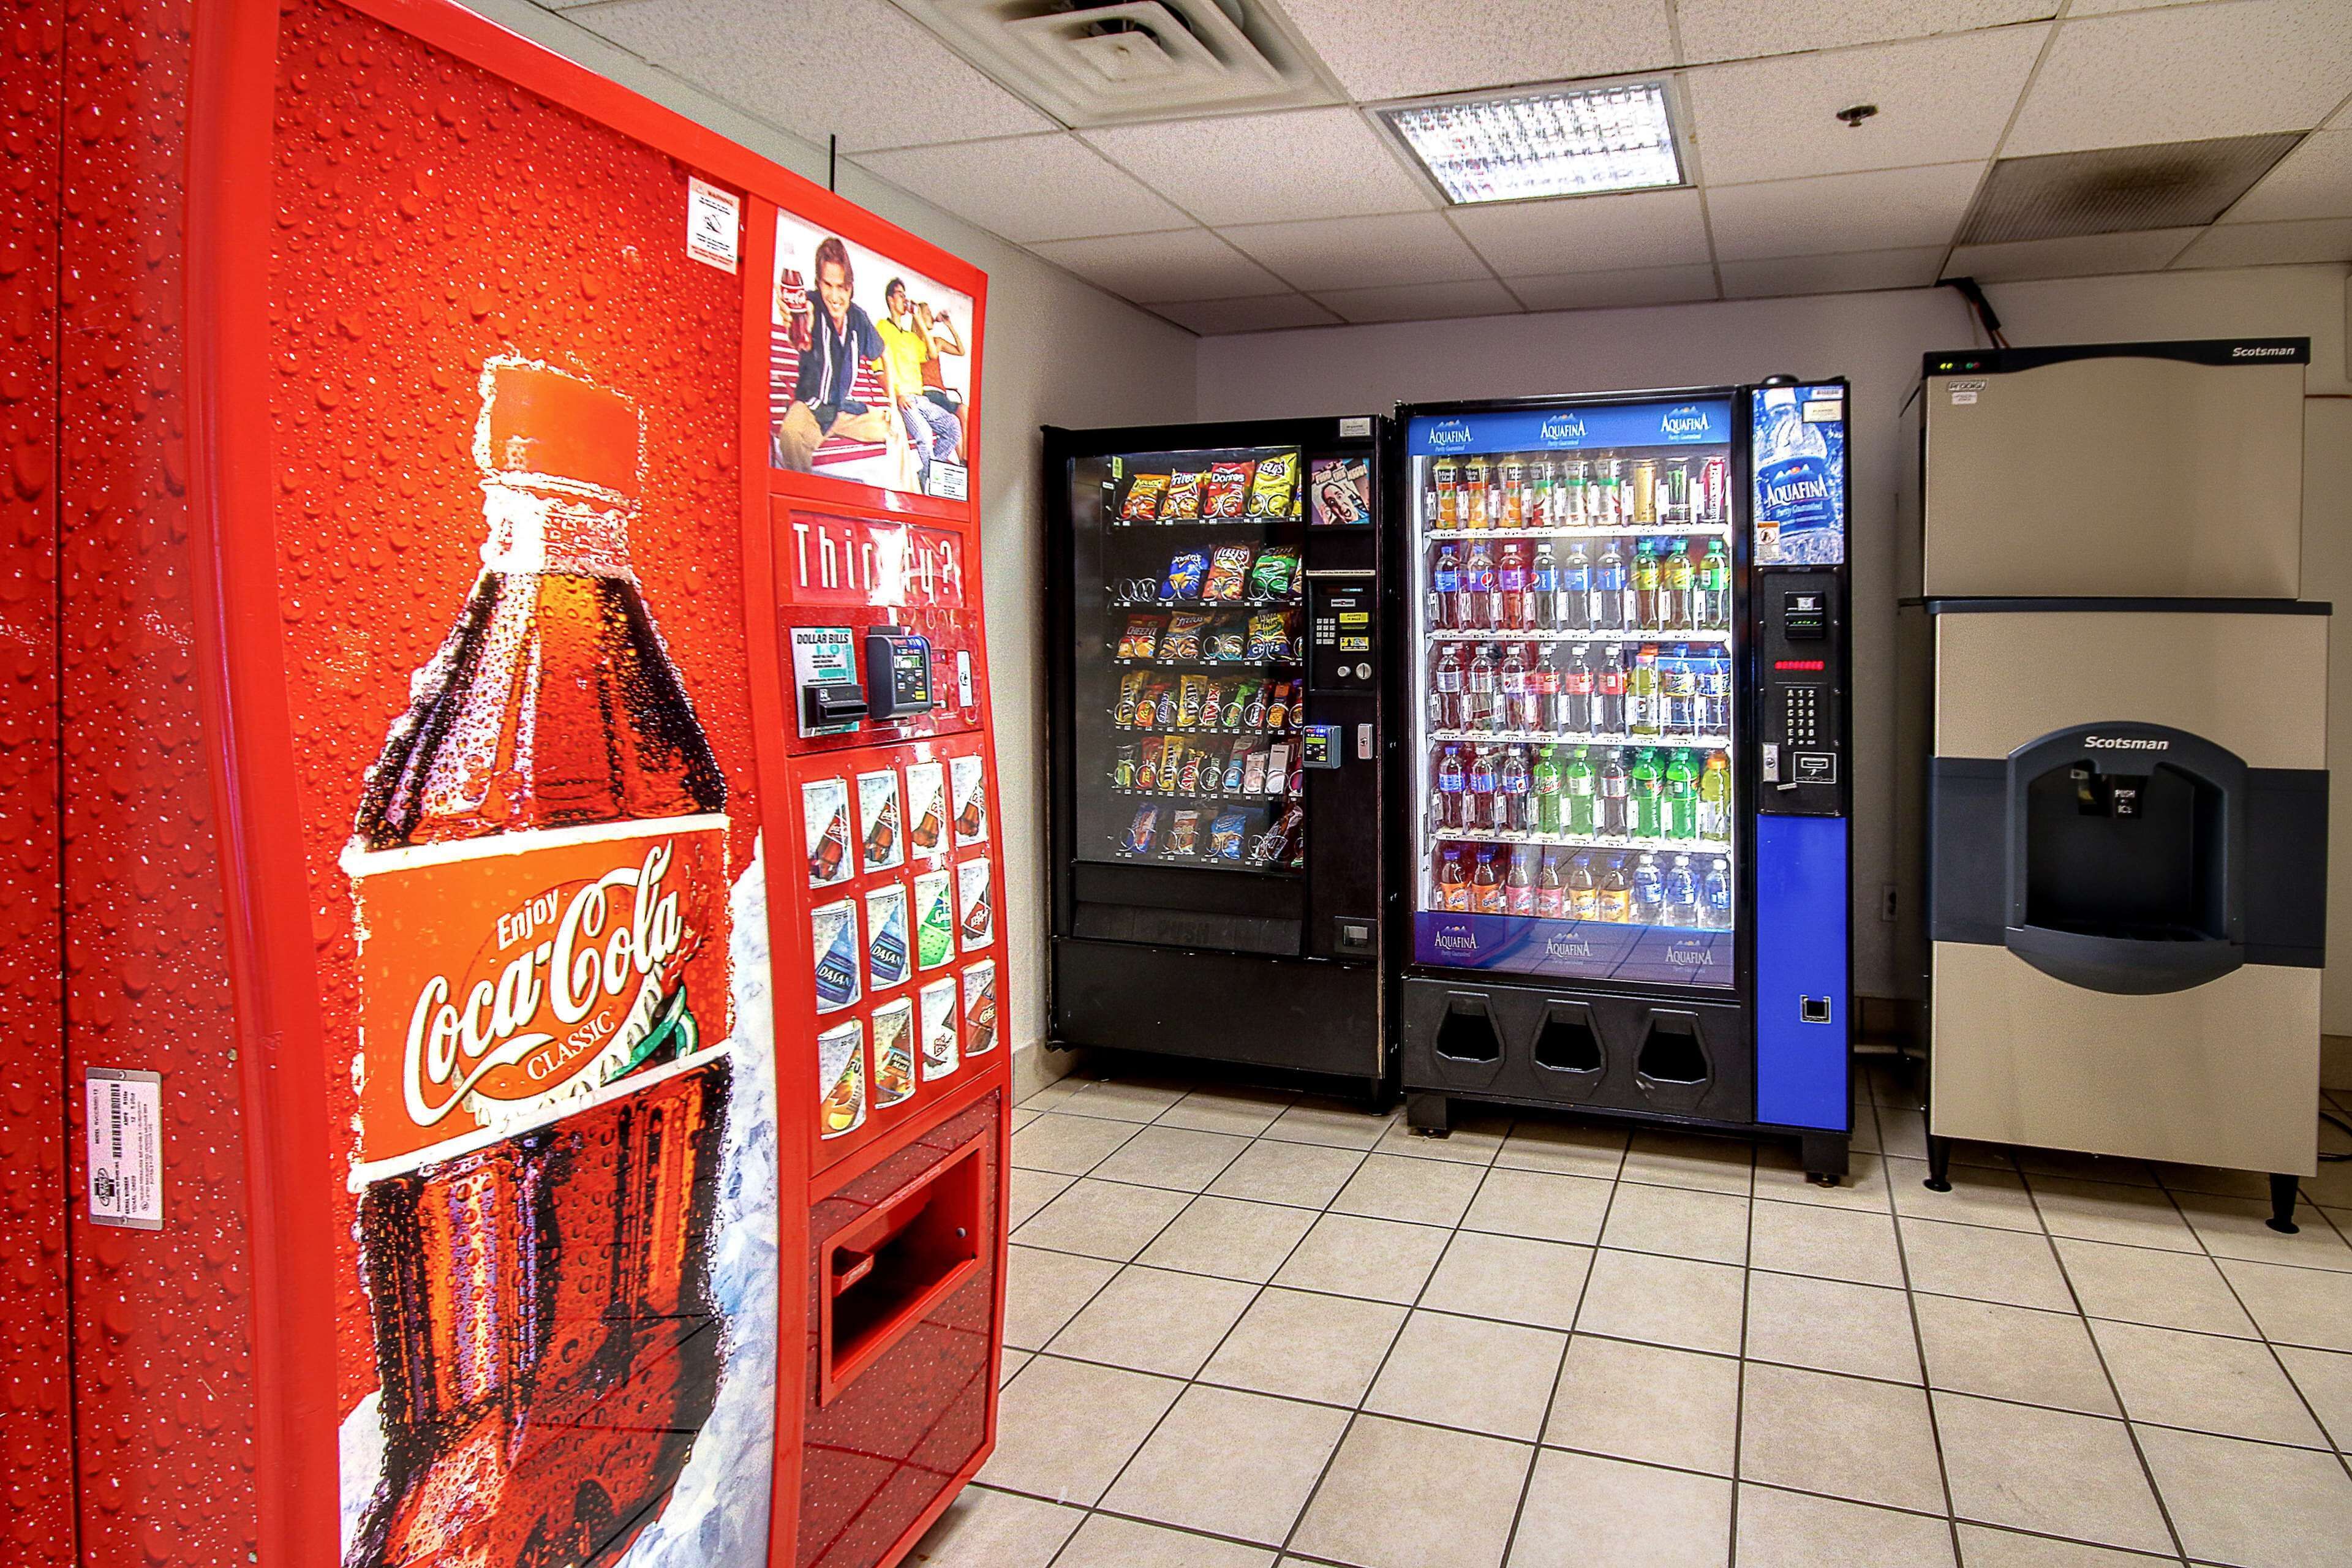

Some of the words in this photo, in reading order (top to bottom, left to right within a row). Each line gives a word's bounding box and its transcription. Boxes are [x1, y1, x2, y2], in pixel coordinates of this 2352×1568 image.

[2232, 347, 2296, 358] Scotsman
[1540, 419, 1586, 440] AQUAFINA
[1661, 412, 1709, 434] AQUAFINA
[1428, 425, 1472, 445] AQUAFINA
[1212, 473, 1245, 483] Doritos
[1766, 473, 1828, 508] AQUAFINA
[793, 522, 953, 603] Thirty?
[797, 634, 827, 644] DOLLAR
[828, 634, 849, 644] BILLS
[2084, 736, 2169, 750] Scotsman
[497, 889, 559, 950] Enjoy
[1434, 931, 1477, 949] AQUAFINA
[1545, 938, 1591, 957] AQUAFINA
[872, 946, 902, 965] DASAN
[1665, 946, 1713, 965] AQUAFINA
[403, 839, 682, 1127] Coca-Cola
[818, 966, 851, 987] DASAN
[527, 1011, 615, 1080] CLASSIC
